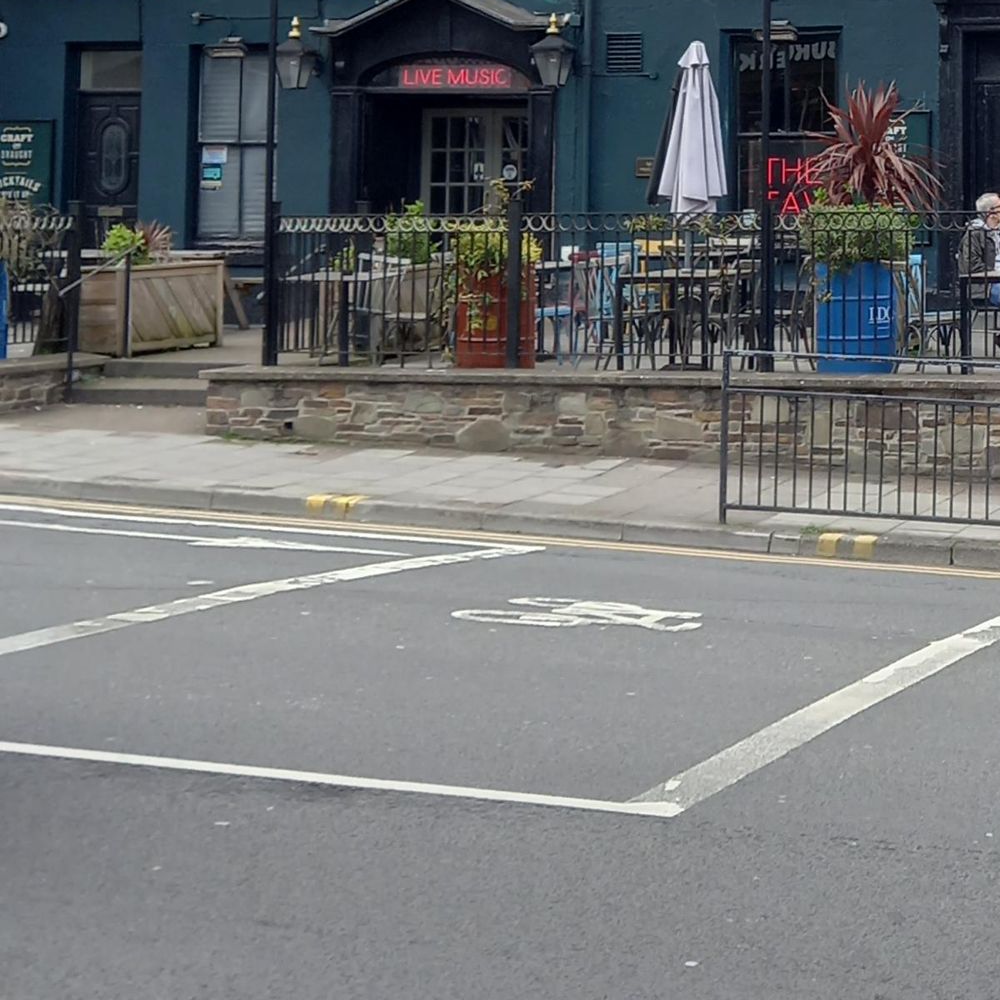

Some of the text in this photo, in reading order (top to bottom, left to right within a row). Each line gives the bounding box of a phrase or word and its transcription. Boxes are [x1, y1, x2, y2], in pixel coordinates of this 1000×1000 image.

[403, 68, 508, 86] LIVE MUSIC
[1, 133, 34, 143] CRAFT
[767, 158, 824, 185] THE
